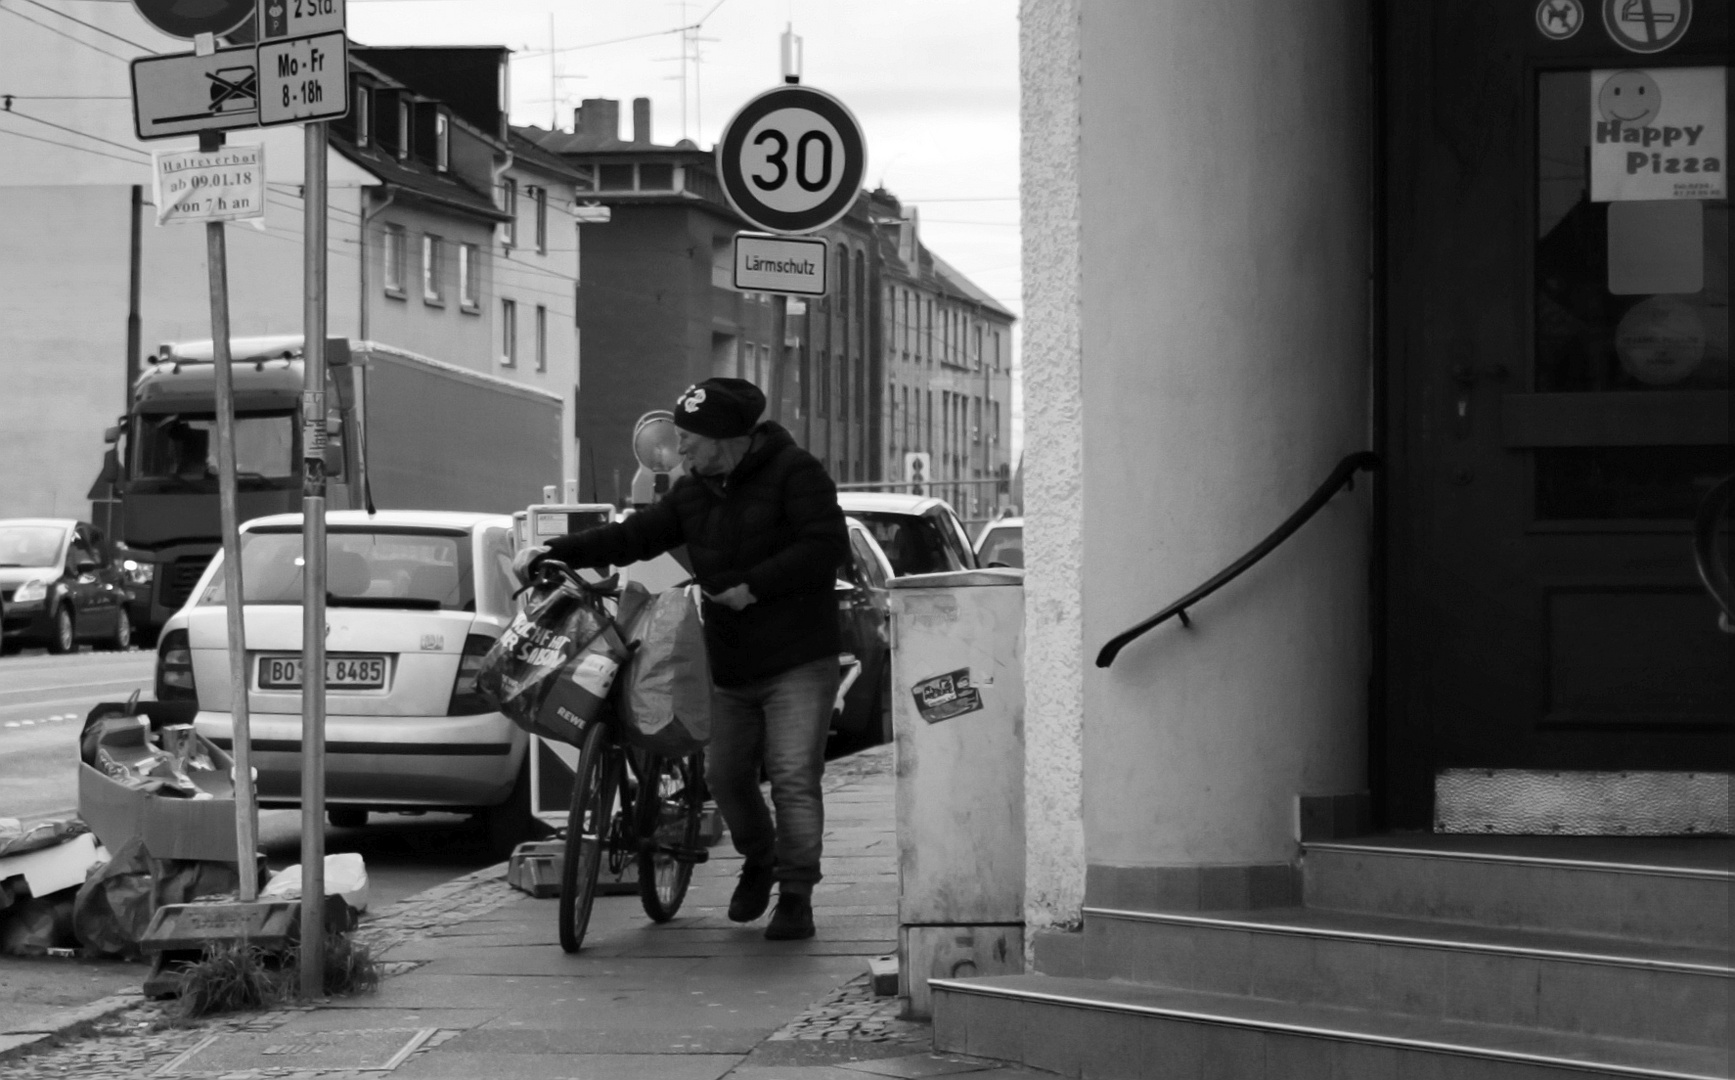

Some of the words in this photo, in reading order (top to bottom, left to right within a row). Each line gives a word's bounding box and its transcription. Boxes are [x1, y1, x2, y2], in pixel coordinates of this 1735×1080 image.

[294, 0, 302, 18] 2
[1595, 119, 1704, 148] Happy
[751, 129, 833, 192] 30
[1626, 151, 1721, 175] Pizza
[170, 178, 187, 193] ab
[191, 172, 252, 189] 09.01.18
[173, 200, 200, 213] von
[218, 197, 227, 211] h
[232, 197, 250, 209] an
[745, 254, 815, 275] Lärmschutz
[271, 661, 295, 682] BO
[335, 661, 381, 682] 8485
[556, 706, 587, 730] REWE
